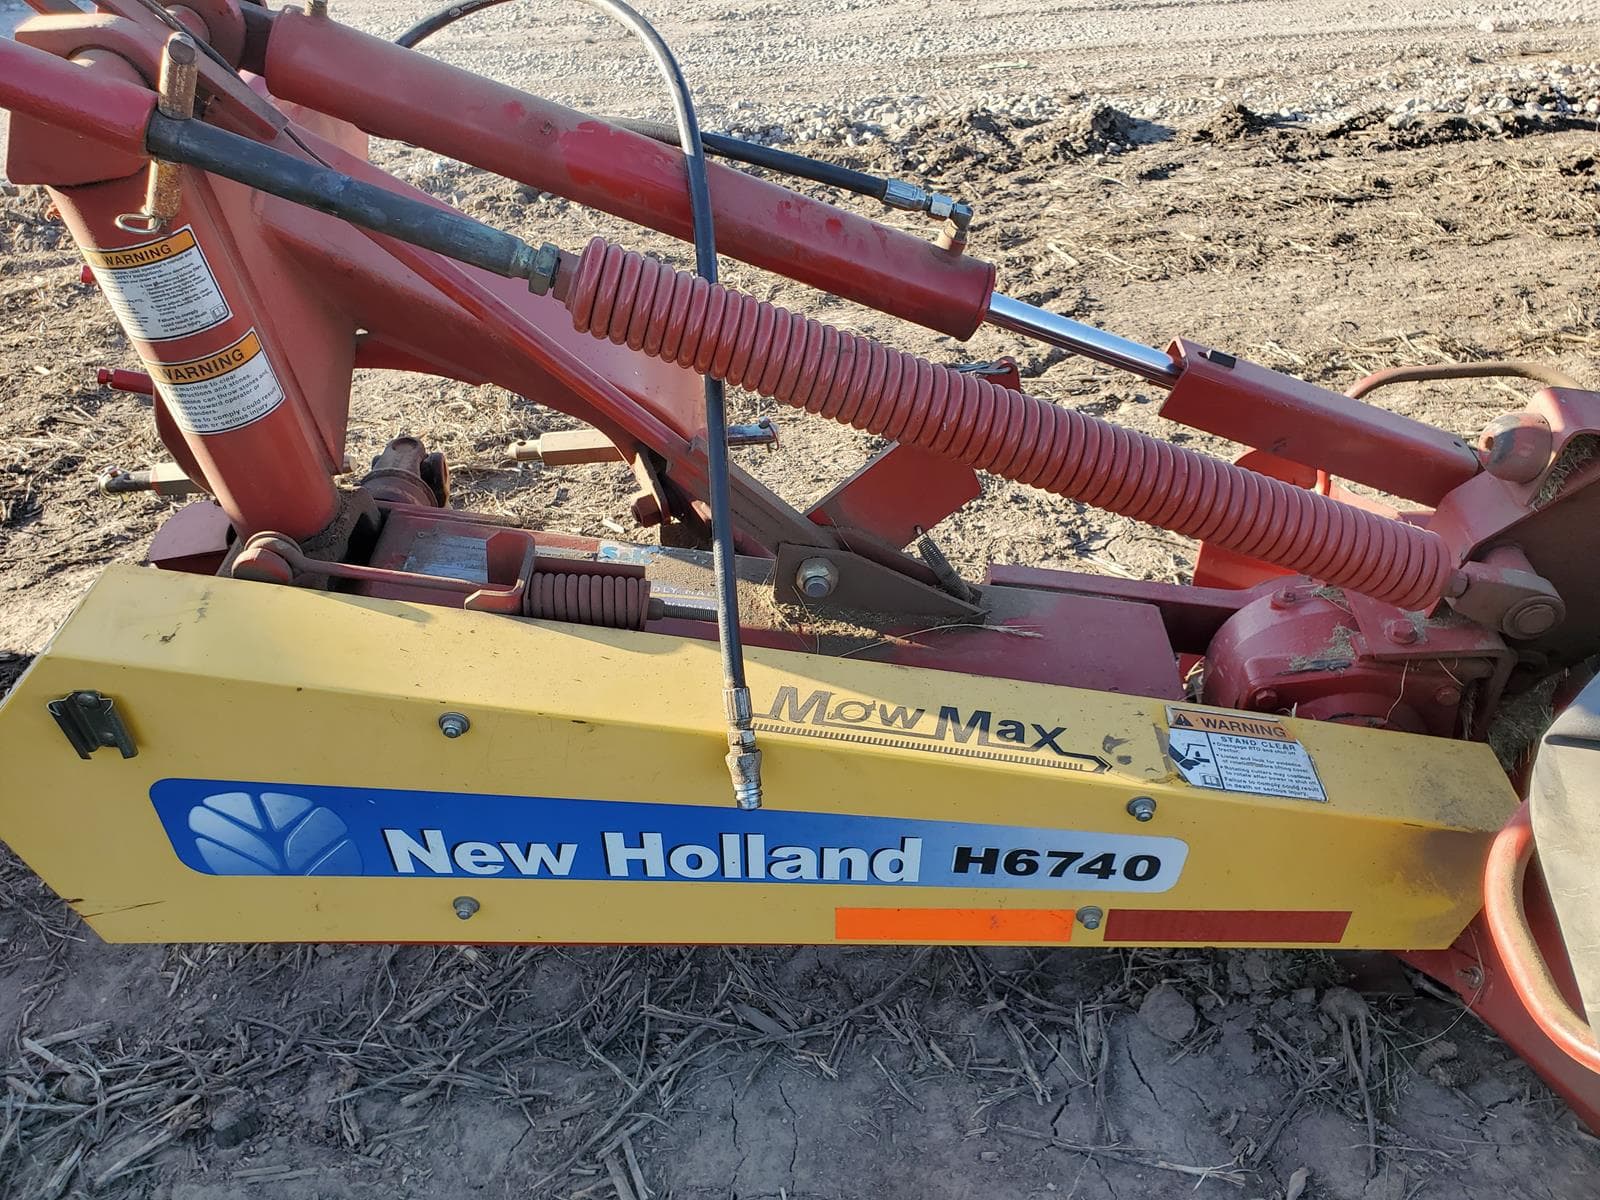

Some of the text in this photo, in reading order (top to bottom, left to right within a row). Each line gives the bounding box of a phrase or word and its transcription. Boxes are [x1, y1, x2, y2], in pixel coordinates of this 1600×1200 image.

[102, 244, 172, 266] WARNING
[769, 685, 1067, 753] Mow Max
[1200, 716, 1287, 737] WARNING
[1220, 735, 1297, 752] STAND CLEAR
[383, 827, 1163, 885] New Holland H6740
